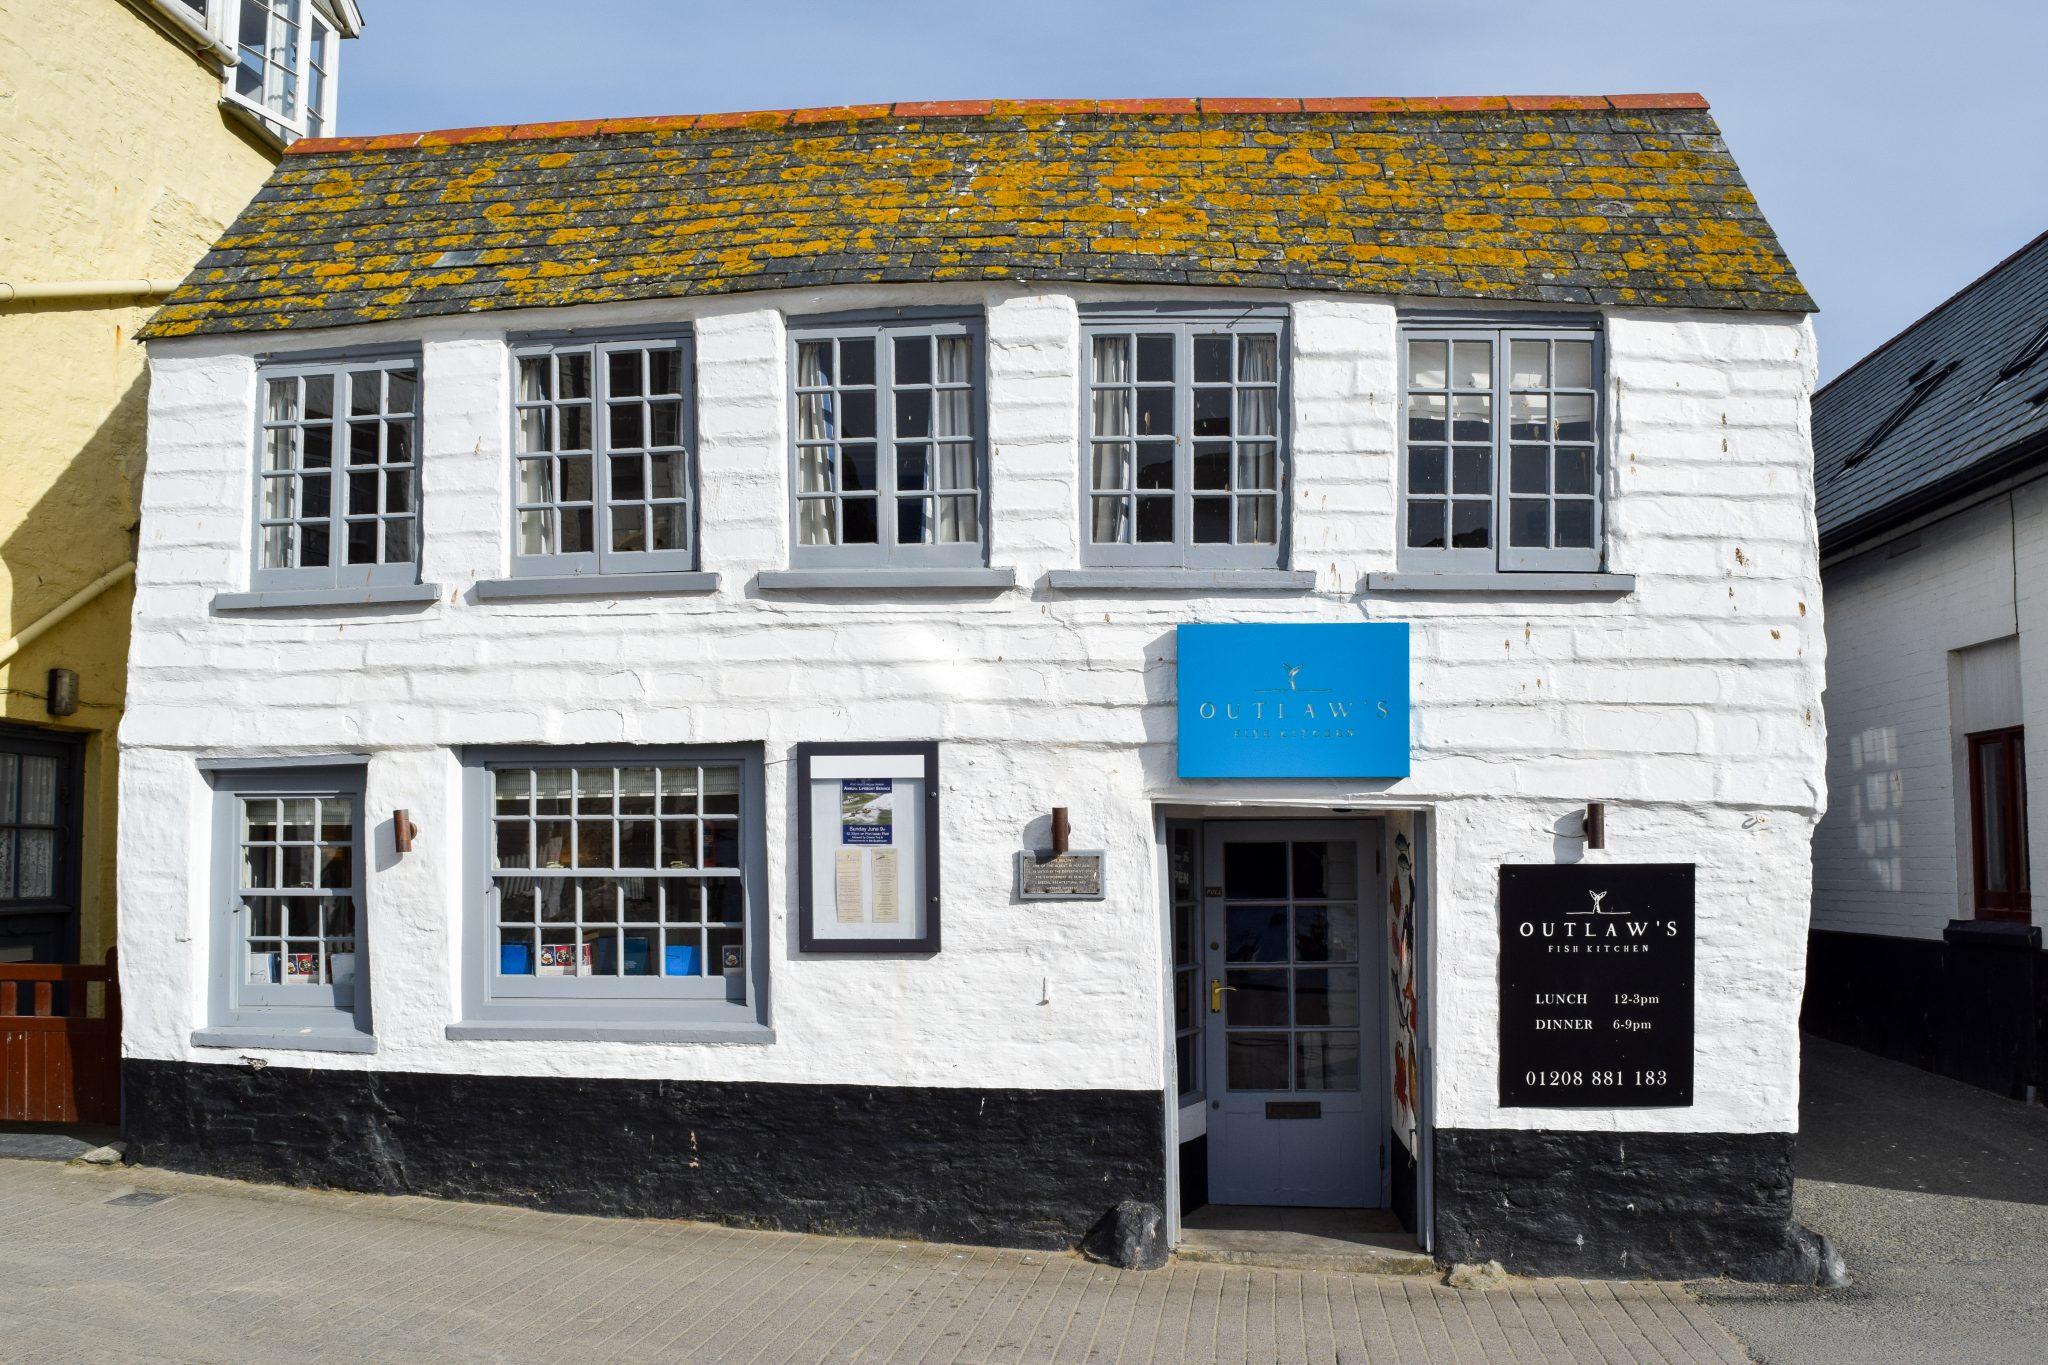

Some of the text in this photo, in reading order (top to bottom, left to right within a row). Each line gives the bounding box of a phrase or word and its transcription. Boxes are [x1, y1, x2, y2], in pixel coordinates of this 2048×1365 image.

[1199, 701, 1389, 720] OUTLAW'S
[1519, 921, 1678, 937] OUTLAW'S
[1548, 944, 1649, 953] FISH KITCHEN
[1535, 994, 1660, 1007] LUNCH 12-3pm
[1535, 1019, 1652, 1032] DINNER 6-9pm
[1526, 1070, 1667, 1086] 01208 881 183
